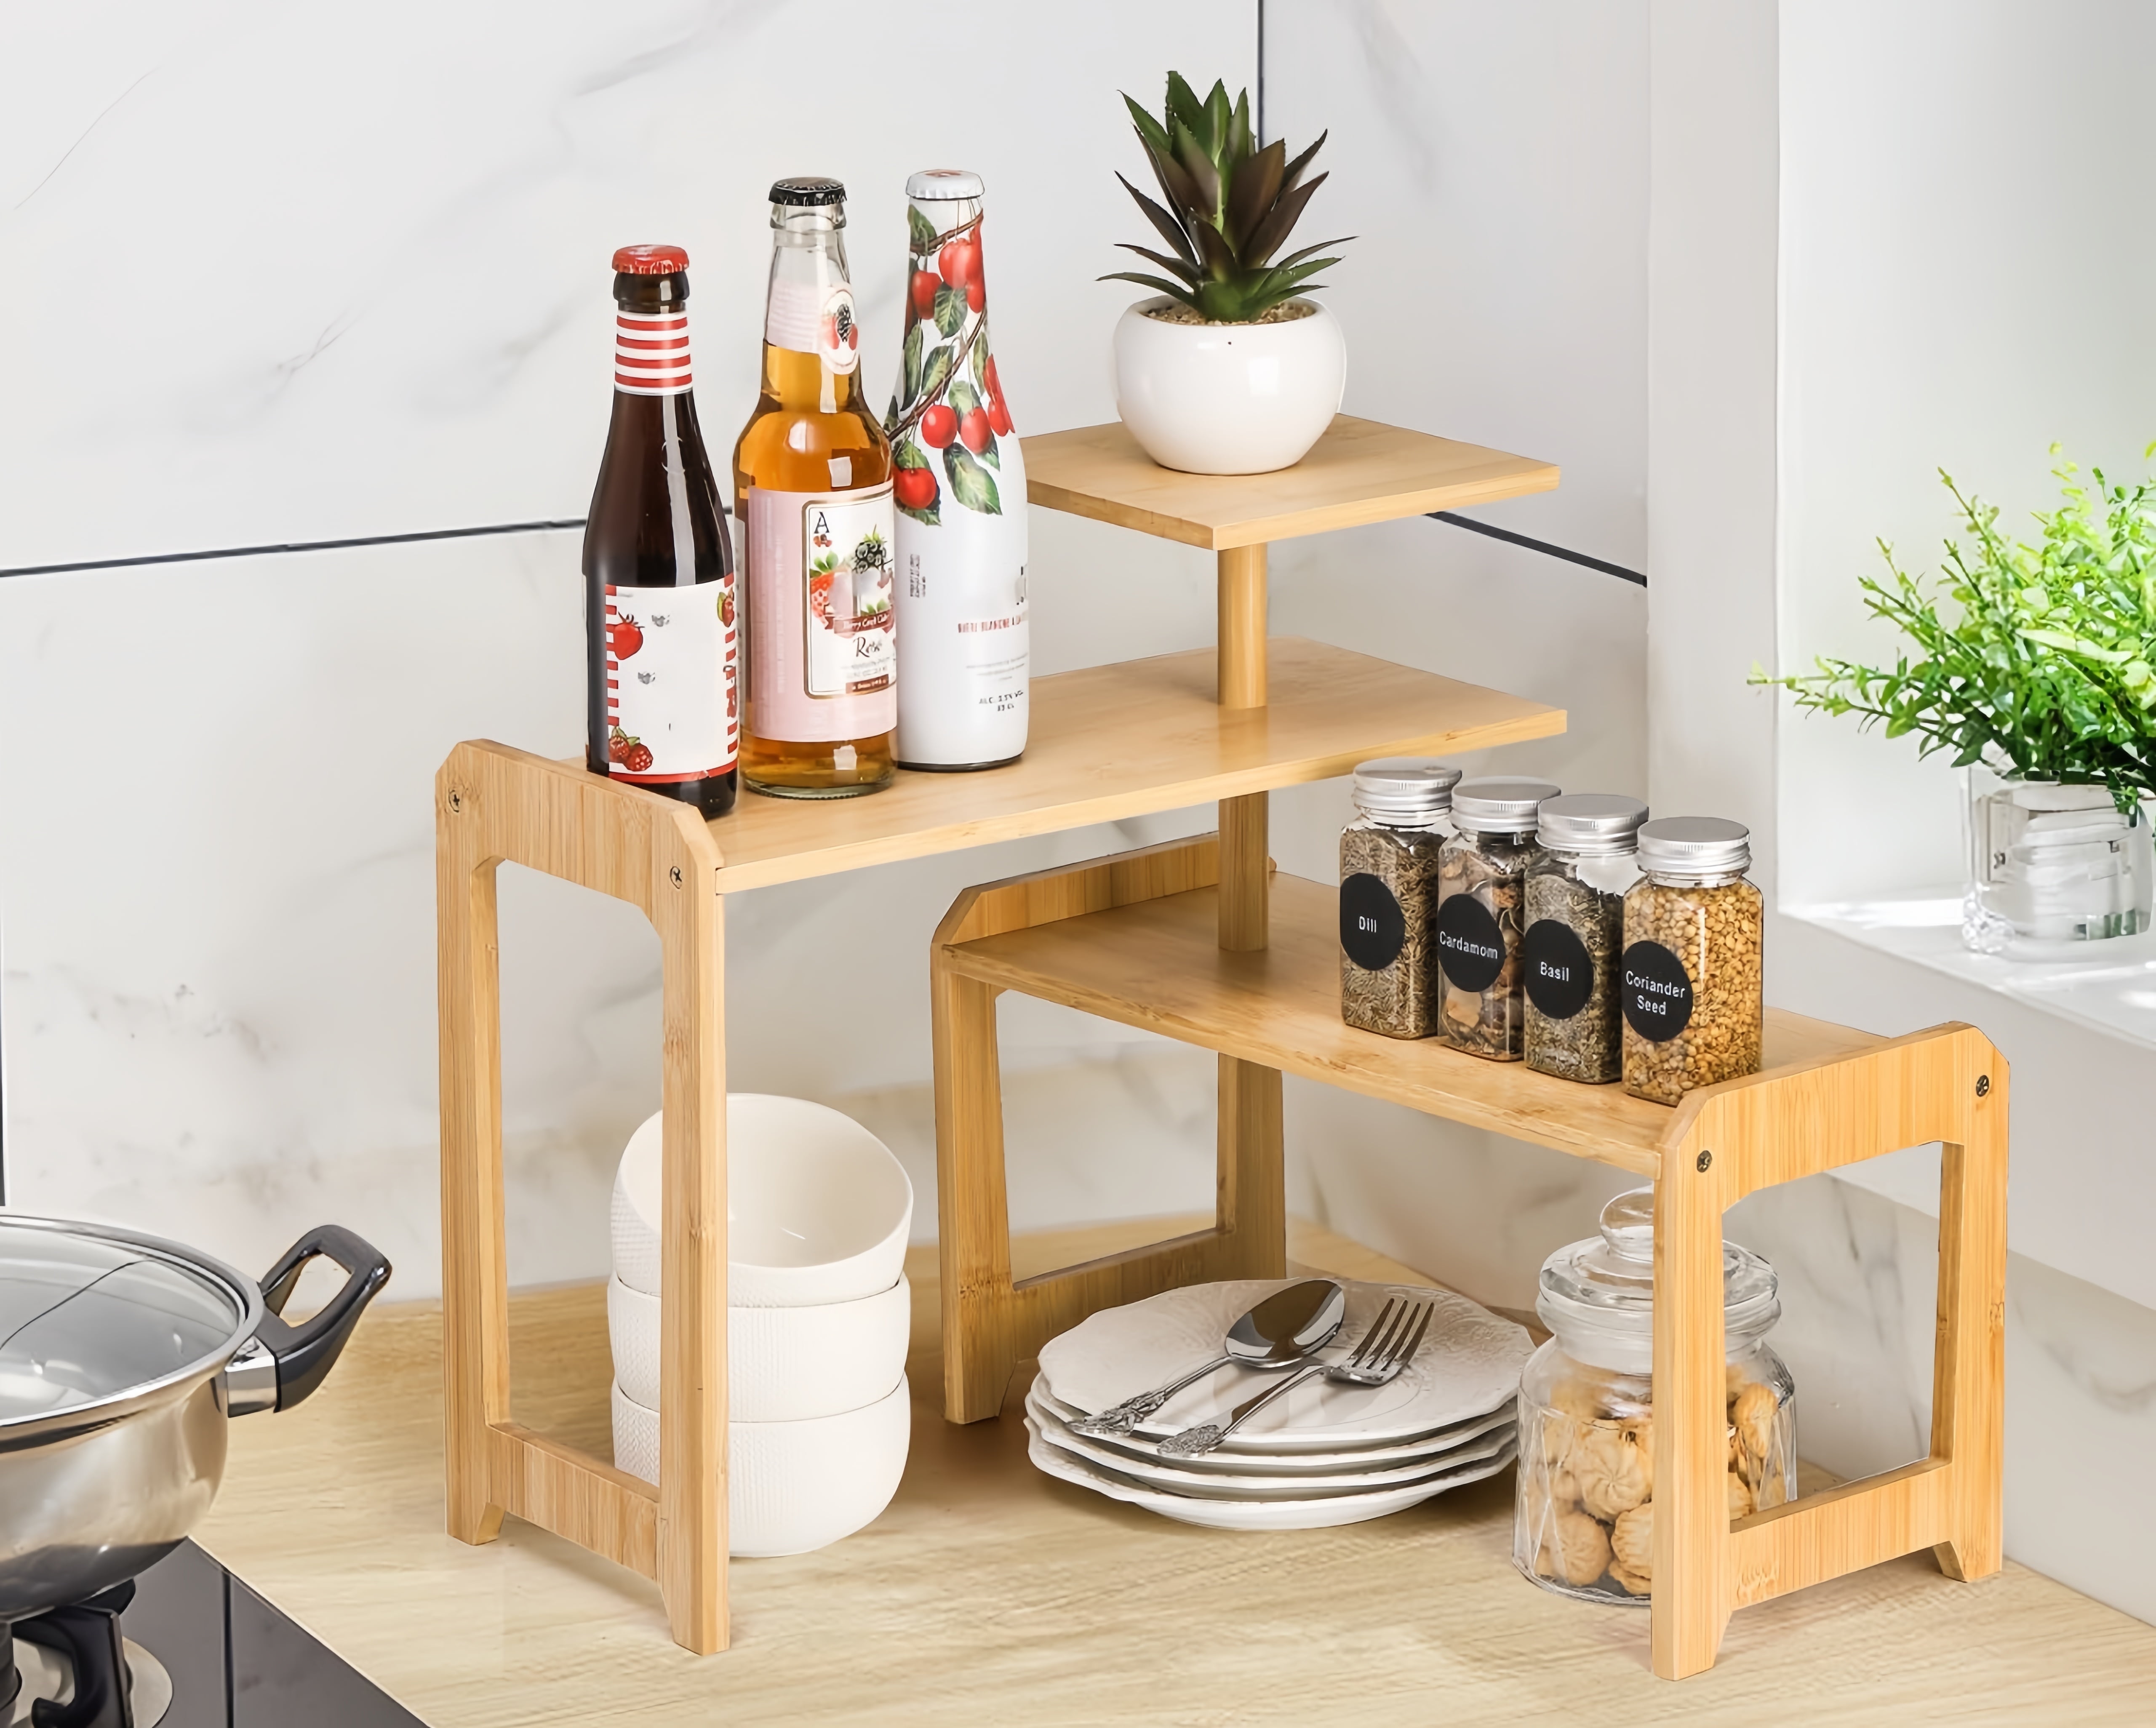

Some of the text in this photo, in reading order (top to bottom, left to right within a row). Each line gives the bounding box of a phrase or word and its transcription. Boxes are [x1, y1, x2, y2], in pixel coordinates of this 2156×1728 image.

[814, 511, 830, 533] A
[1358, 915, 1377, 933] Dill
[1439, 931, 1498, 960] Cardamom
[1540, 961, 1569, 982] Basil
[1625, 970, 1686, 998] Coriander
[1637, 995, 1667, 1016] Seed
